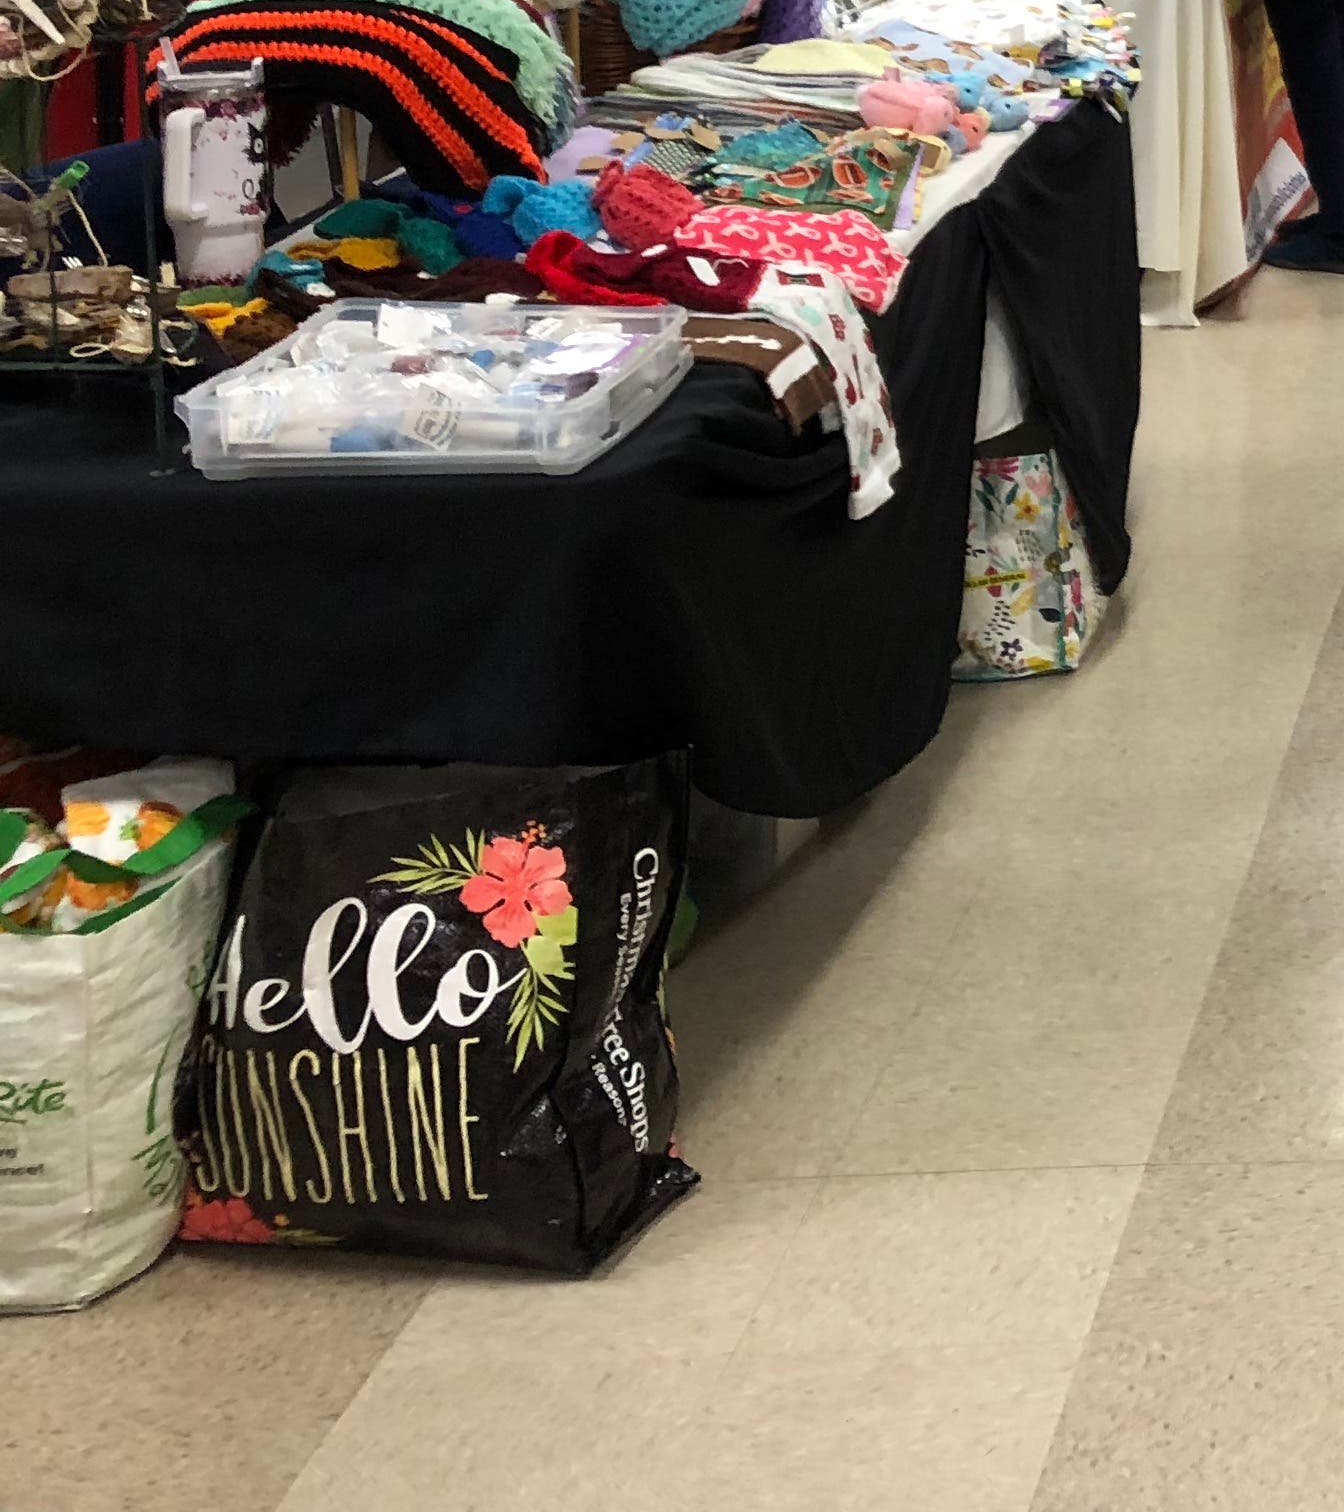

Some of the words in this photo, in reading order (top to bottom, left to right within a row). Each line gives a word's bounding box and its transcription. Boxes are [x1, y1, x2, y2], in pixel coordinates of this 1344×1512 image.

[206, 896, 528, 1055] Hello
[616, 892, 632, 941] Every
[196, 1034, 489, 1204] SUNSHINE
[619, 1061, 649, 1153] Shops
